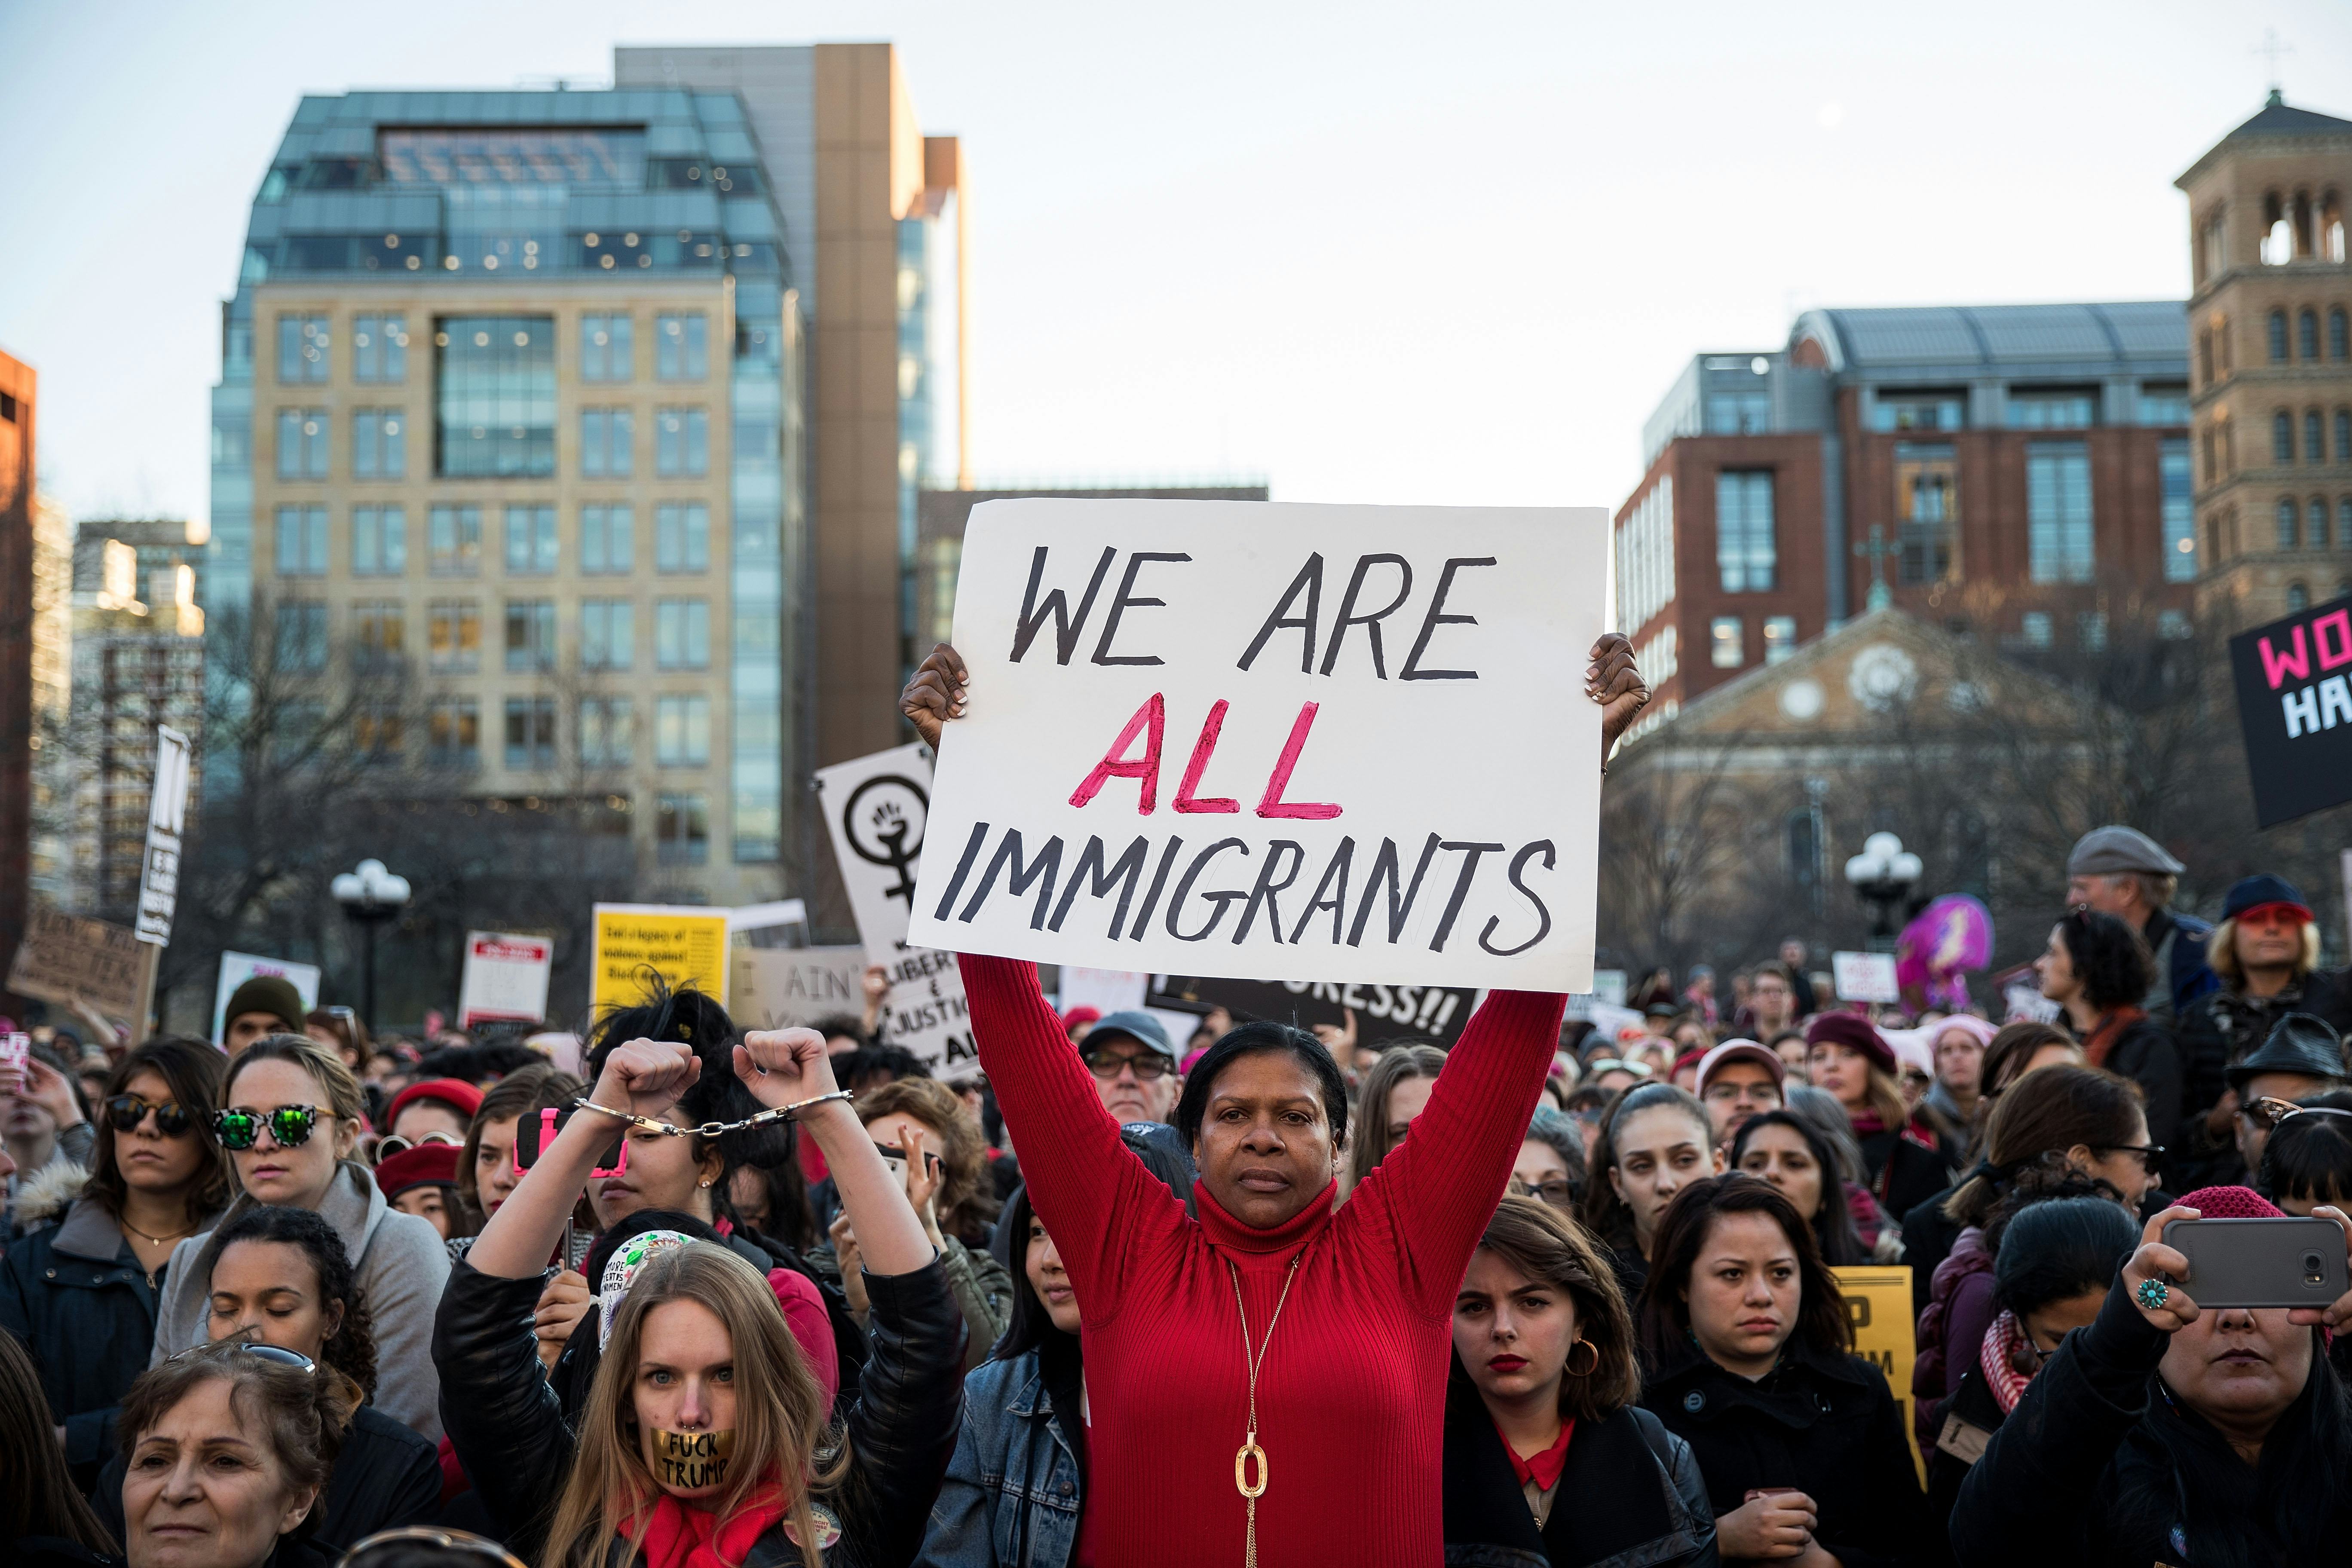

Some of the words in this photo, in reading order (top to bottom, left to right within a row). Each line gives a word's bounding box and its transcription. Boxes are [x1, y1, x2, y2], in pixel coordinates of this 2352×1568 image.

[1010, 546, 1191, 666] WE
[1237, 551, 1497, 681] ARE
[2281, 671, 2352, 739] HA
[1069, 692, 1342, 820] ALL
[934, 822, 1555, 958] IMMIGRANTS
[885, 948, 958, 986] LIBER
[1254, 979, 1460, 1036] RESS!!
[606, 1261, 625, 1272] MORE
[670, 1433, 718, 1457] FUCK
[662, 1458, 728, 1488] TRUMP
[813, 1505, 837, 1525] SANDERS
